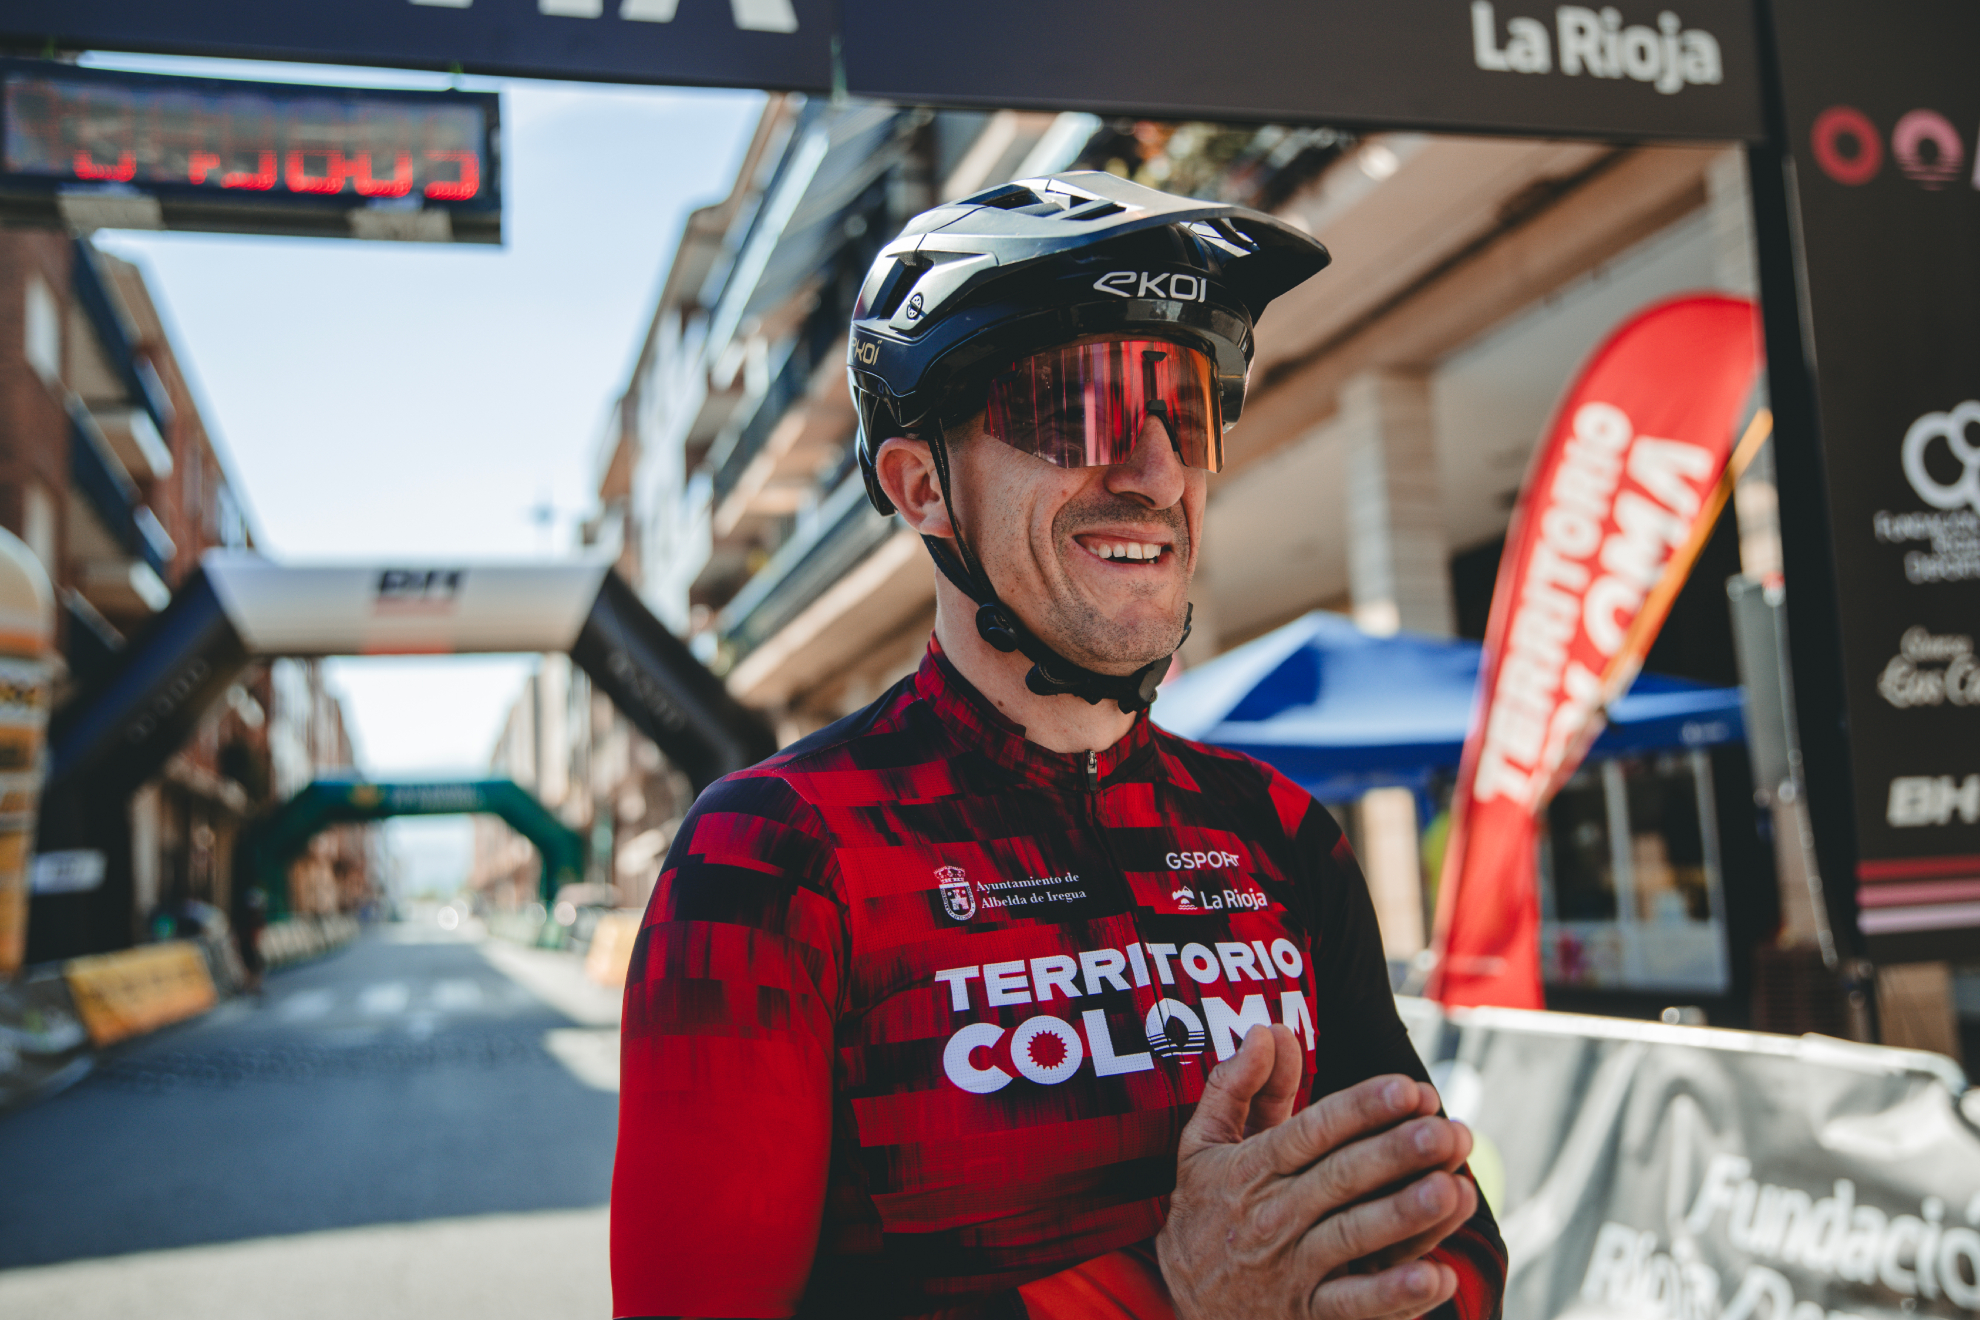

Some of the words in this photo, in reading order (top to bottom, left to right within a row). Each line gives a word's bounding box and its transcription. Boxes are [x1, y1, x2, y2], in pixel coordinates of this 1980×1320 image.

[1470, 0, 1552, 74] La
[1555, 5, 1724, 95] Rioja
[1473, 402, 1633, 801] TERRITORIO
[1165, 850, 1240, 870] GSPORT
[976, 875, 1062, 895] Ayuntamiento
[1065, 871, 1080, 883] de
[981, 893, 1027, 909] Albelda
[1030, 892, 1045, 904] de
[1046, 889, 1087, 903] Iregua
[1200, 890, 1223, 910] La
[1223, 887, 1268, 910] Rioja
[934, 937, 1303, 1012] TERRITORIO
